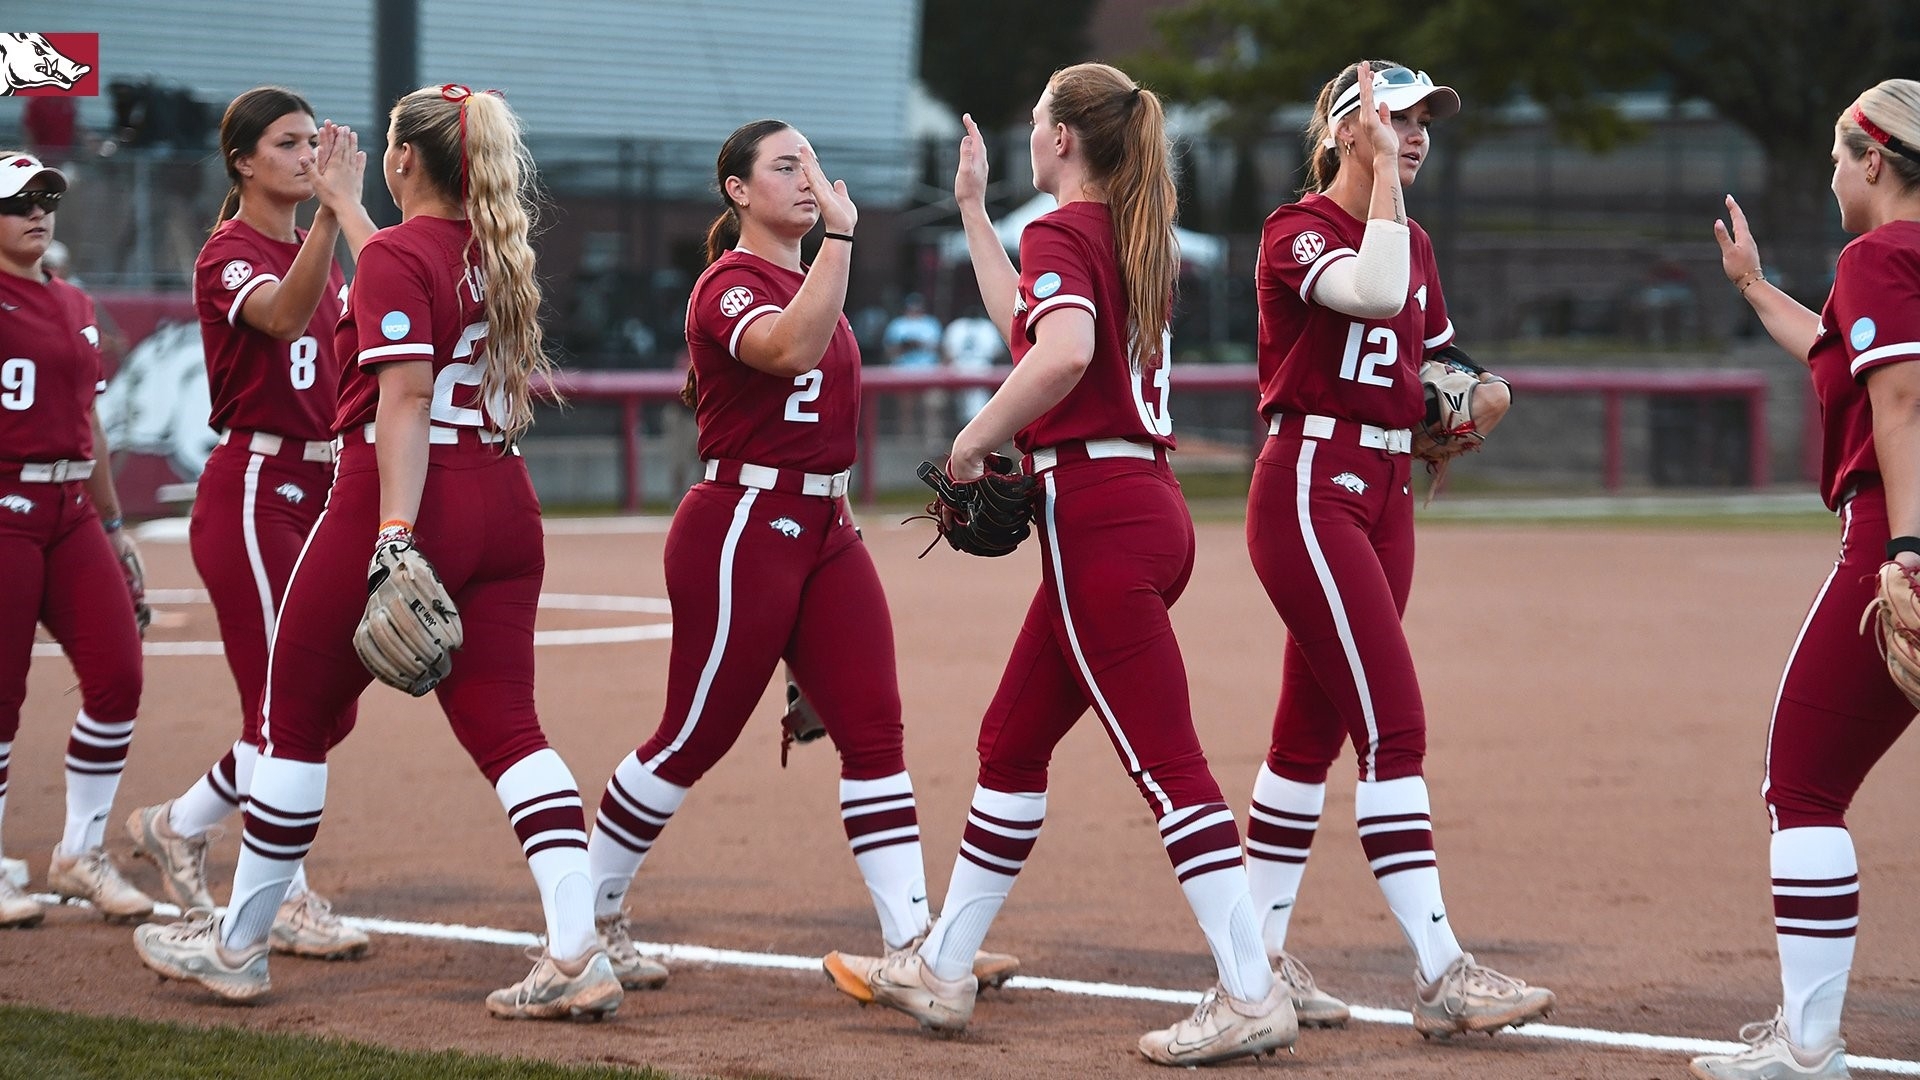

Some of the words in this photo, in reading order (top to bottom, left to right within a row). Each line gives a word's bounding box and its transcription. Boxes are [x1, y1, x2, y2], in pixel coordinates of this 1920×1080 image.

[1294, 232, 1324, 262] SEC
[222, 261, 251, 288] SEC
[722, 288, 752, 315] SEC
[289, 335, 318, 390] 8
[1339, 322, 1398, 388] 12
[0, 357, 36, 411] 9
[784, 368, 824, 423] 2
